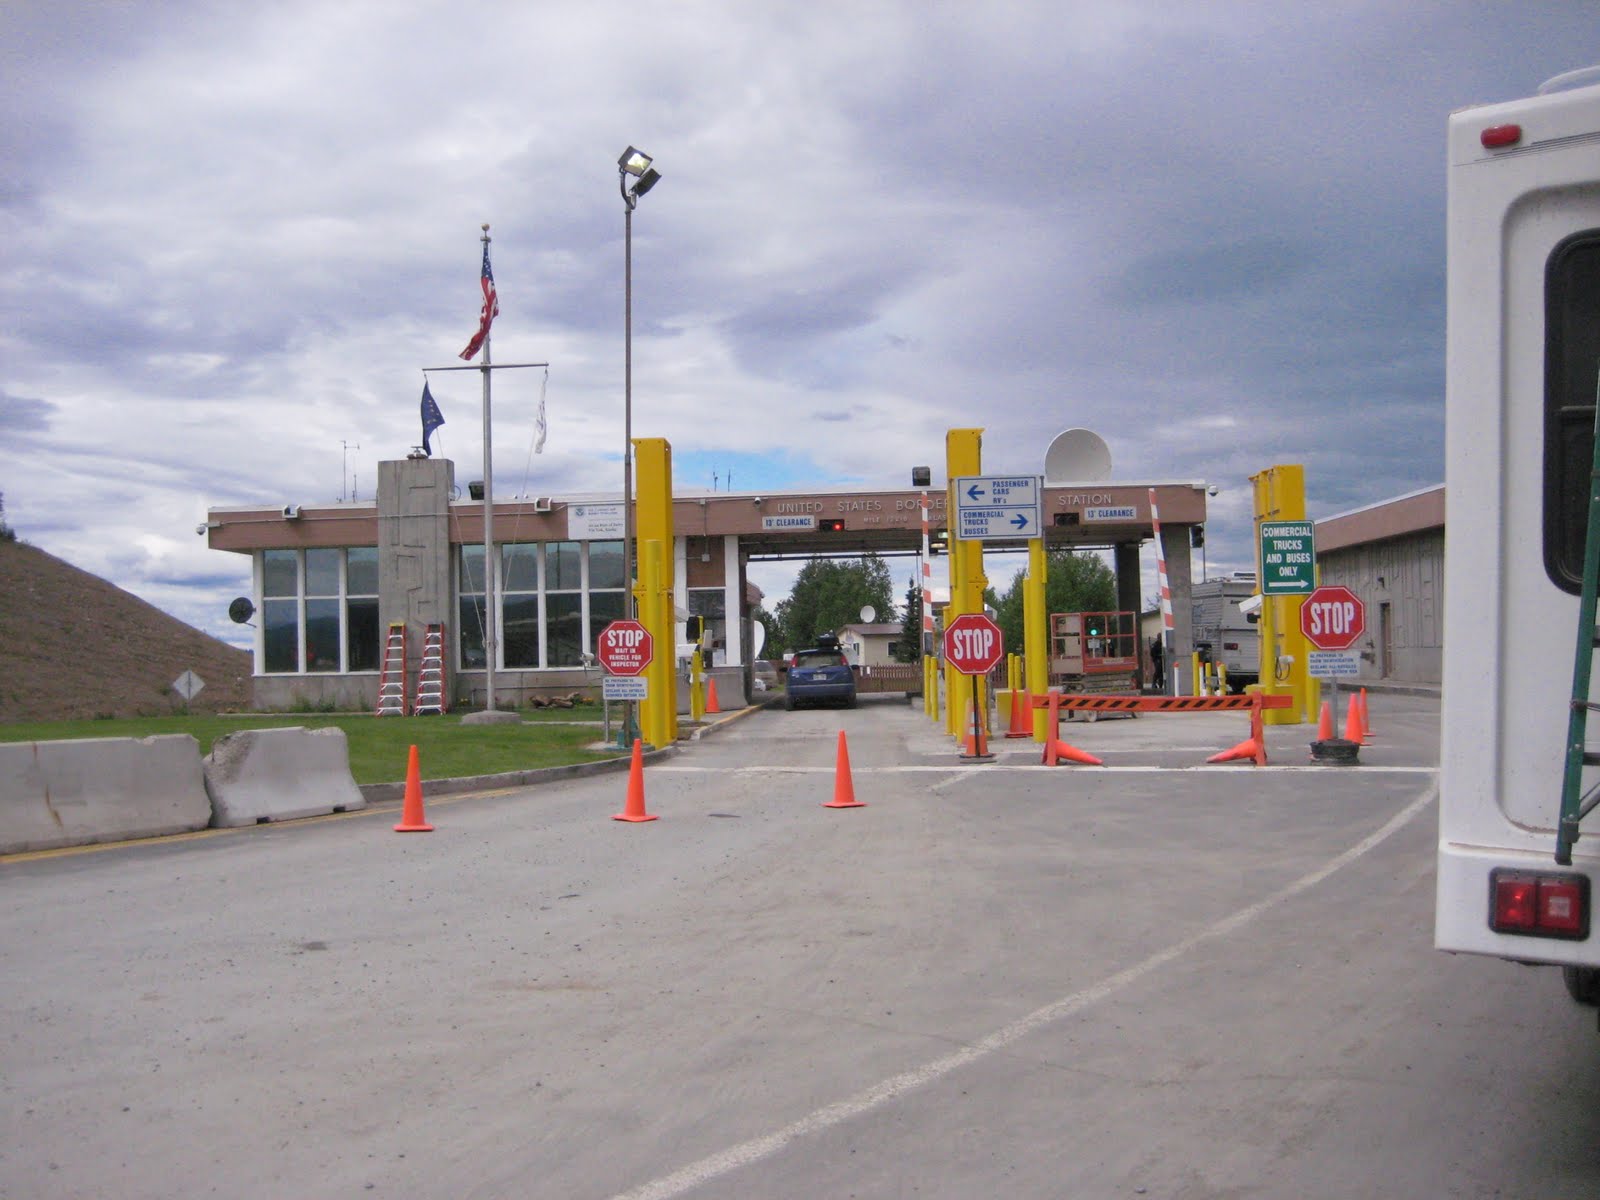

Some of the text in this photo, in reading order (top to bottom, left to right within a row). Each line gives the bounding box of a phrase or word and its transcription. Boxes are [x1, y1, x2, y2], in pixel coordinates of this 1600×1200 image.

[778, 502, 824, 512] UNITED
[838, 500, 882, 512] STATES
[1058, 494, 1112, 505] STATION
[1098, 509, 1134, 517] CLEARANCE
[776, 518, 812, 527] CLEARANCE
[1263, 527, 1311, 537] COMMERCIAL
[1273, 540, 1302, 550] TRUCKS
[1266, 553, 1311, 564] AND BUSES
[1279, 567, 1298, 576] ONLY
[1311, 602, 1354, 635] STOP
[607, 630, 644, 647] STOP
[953, 628, 993, 660] STOP
